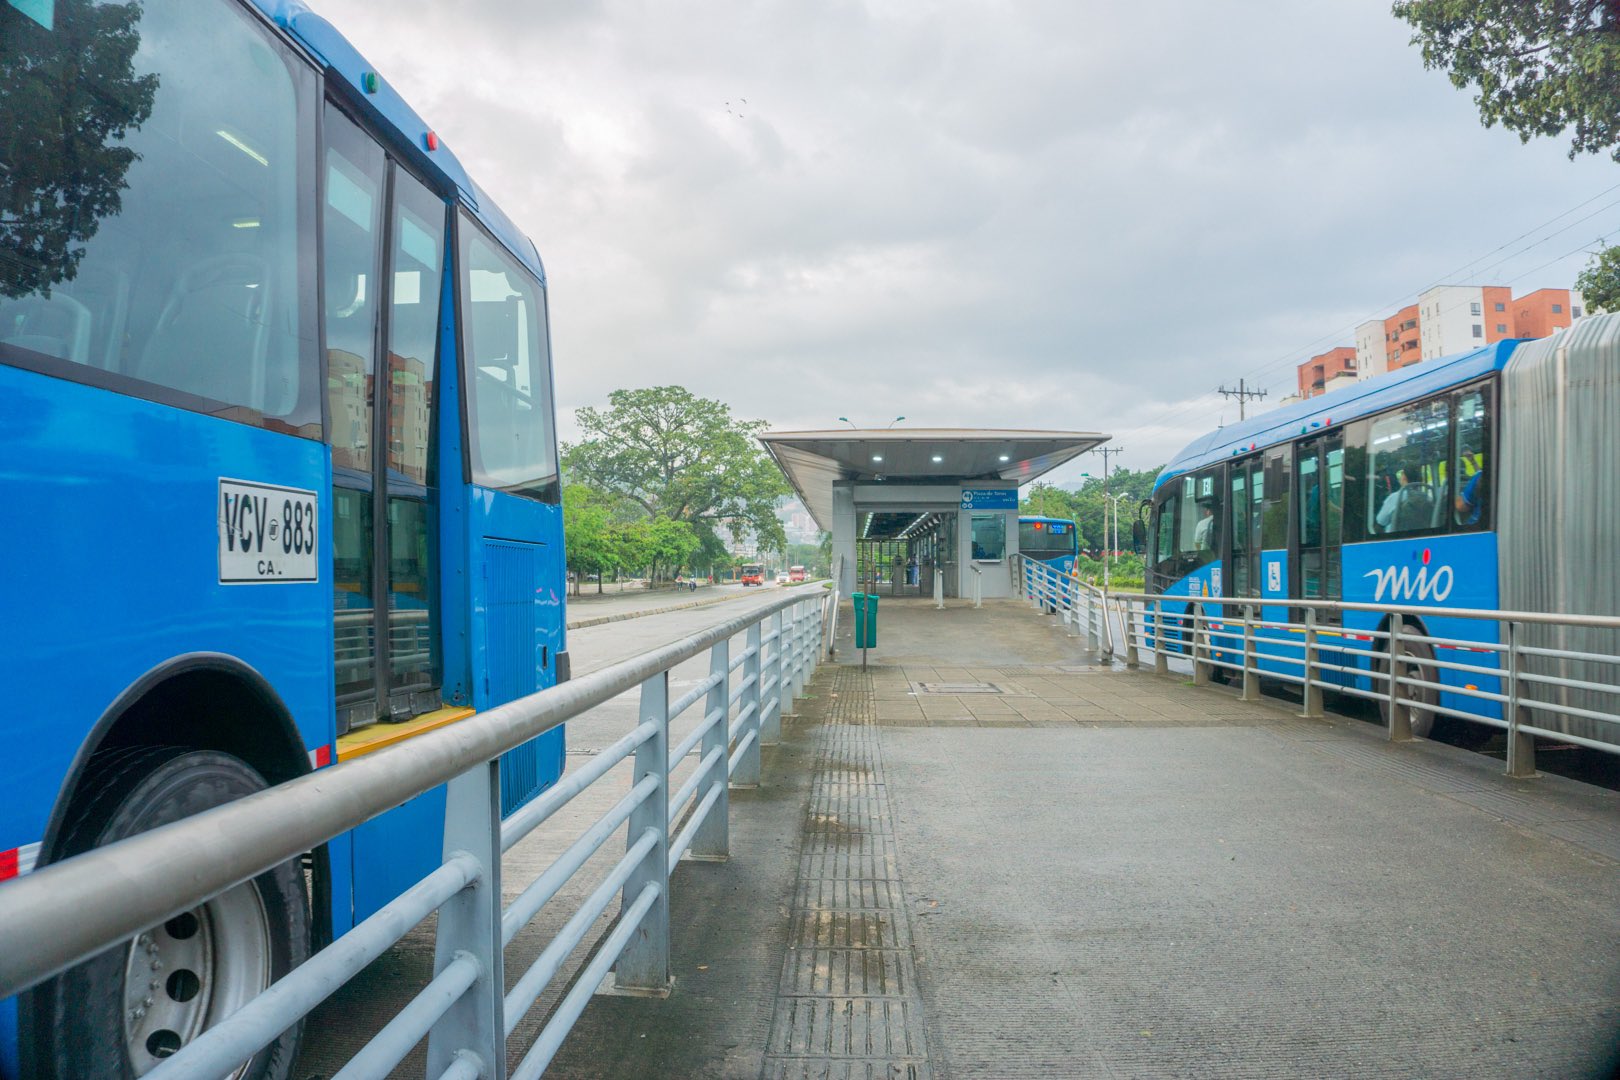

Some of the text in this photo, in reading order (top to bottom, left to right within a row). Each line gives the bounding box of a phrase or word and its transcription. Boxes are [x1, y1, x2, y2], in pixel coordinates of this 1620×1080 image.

[223, 492, 314, 555] VCV 883
[257, 560, 282, 575] CA.
[1362, 547, 1454, 602] mio
